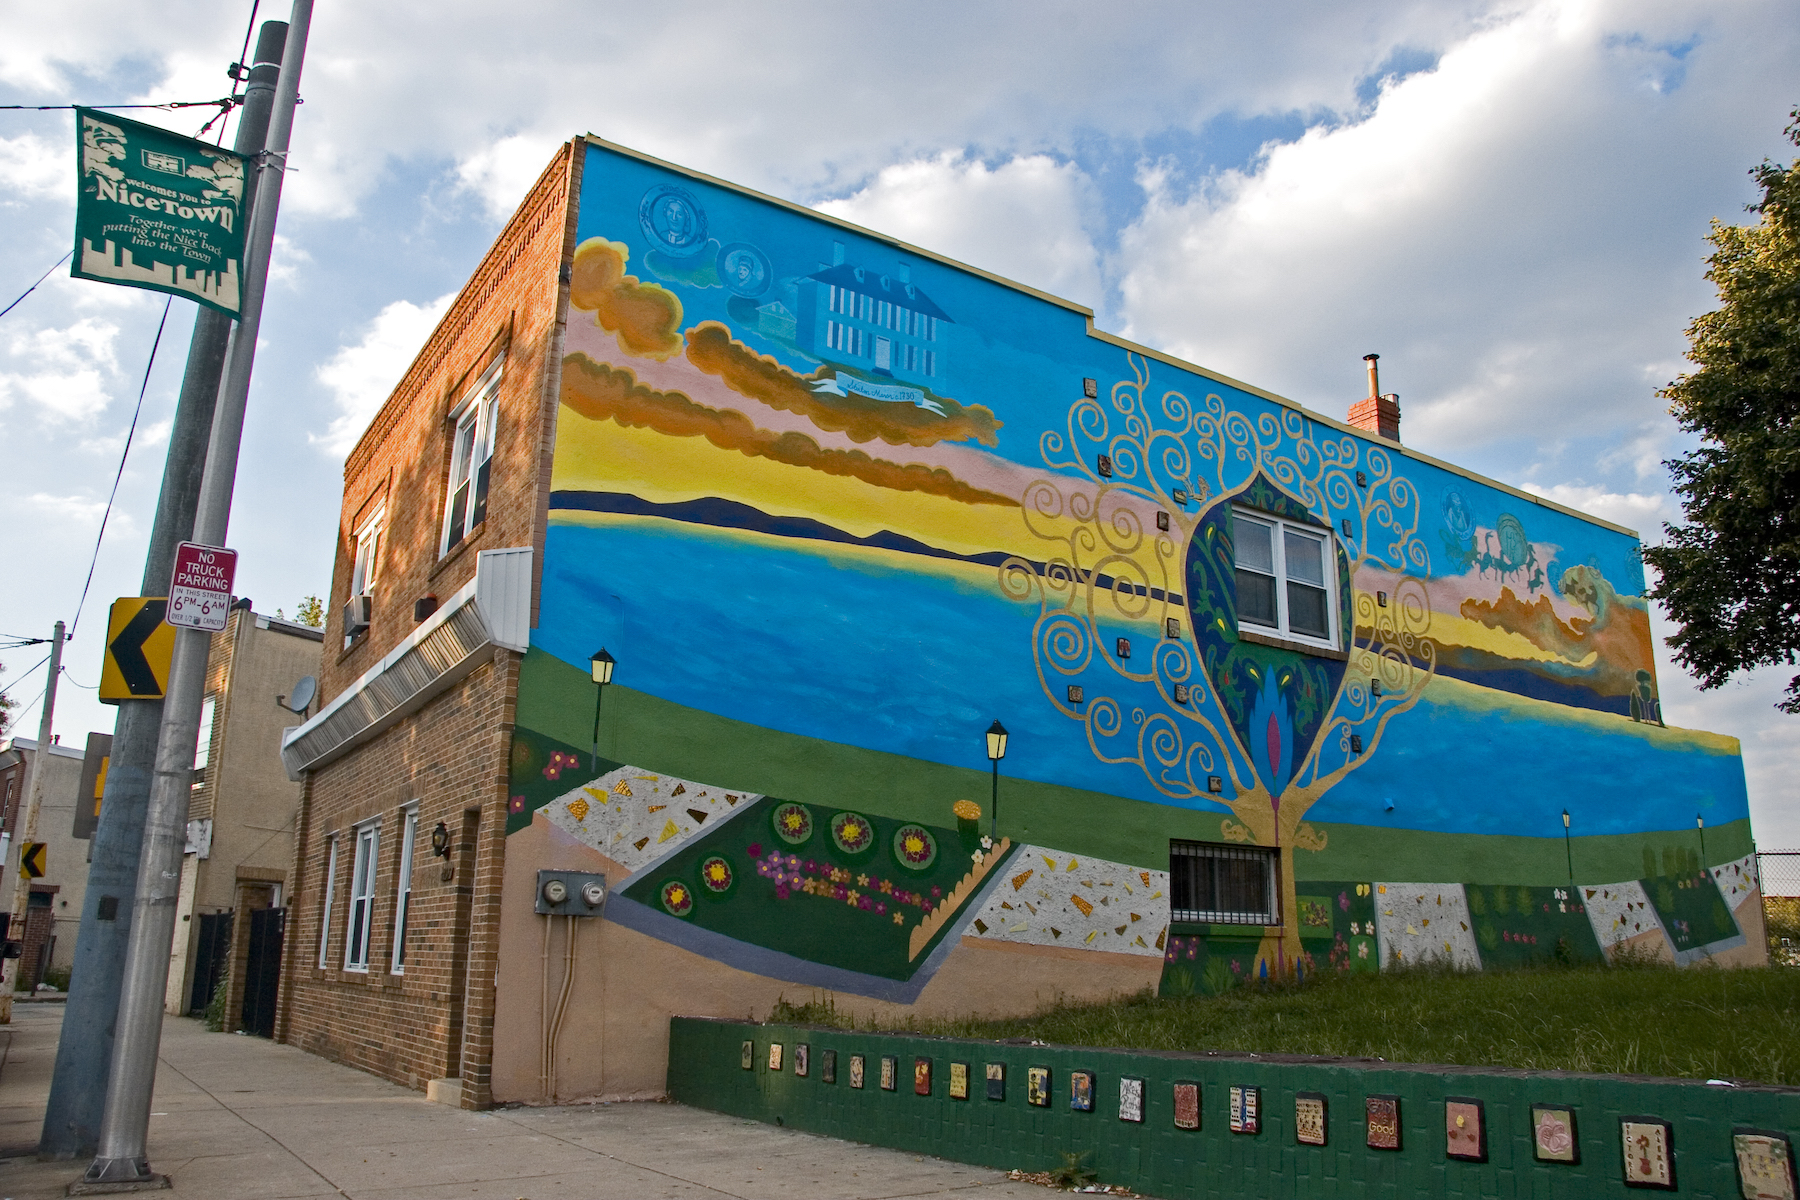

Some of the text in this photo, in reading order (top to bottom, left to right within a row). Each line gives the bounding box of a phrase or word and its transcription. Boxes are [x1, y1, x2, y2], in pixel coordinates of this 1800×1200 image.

[126, 178, 177, 198] welcomes
[179, 192, 198, 204] you
[102, 223, 148, 239] putting
[152, 228, 170, 240] the
[173, 233, 198, 247] Nice
[129, 214, 208, 239] Together we're
[132, 235, 211, 262] Into the Town
[198, 552, 215, 564] NO
[186, 561, 224, 578] TRUCK
[177, 572, 229, 591] PARKING
[185, 589, 201, 597] THIS
[202, 591, 227, 601] STREET
[171, 612, 184, 621] OVER
[203, 617, 224, 627] CAPACITY
[1369, 1121, 1395, 1135] Good
